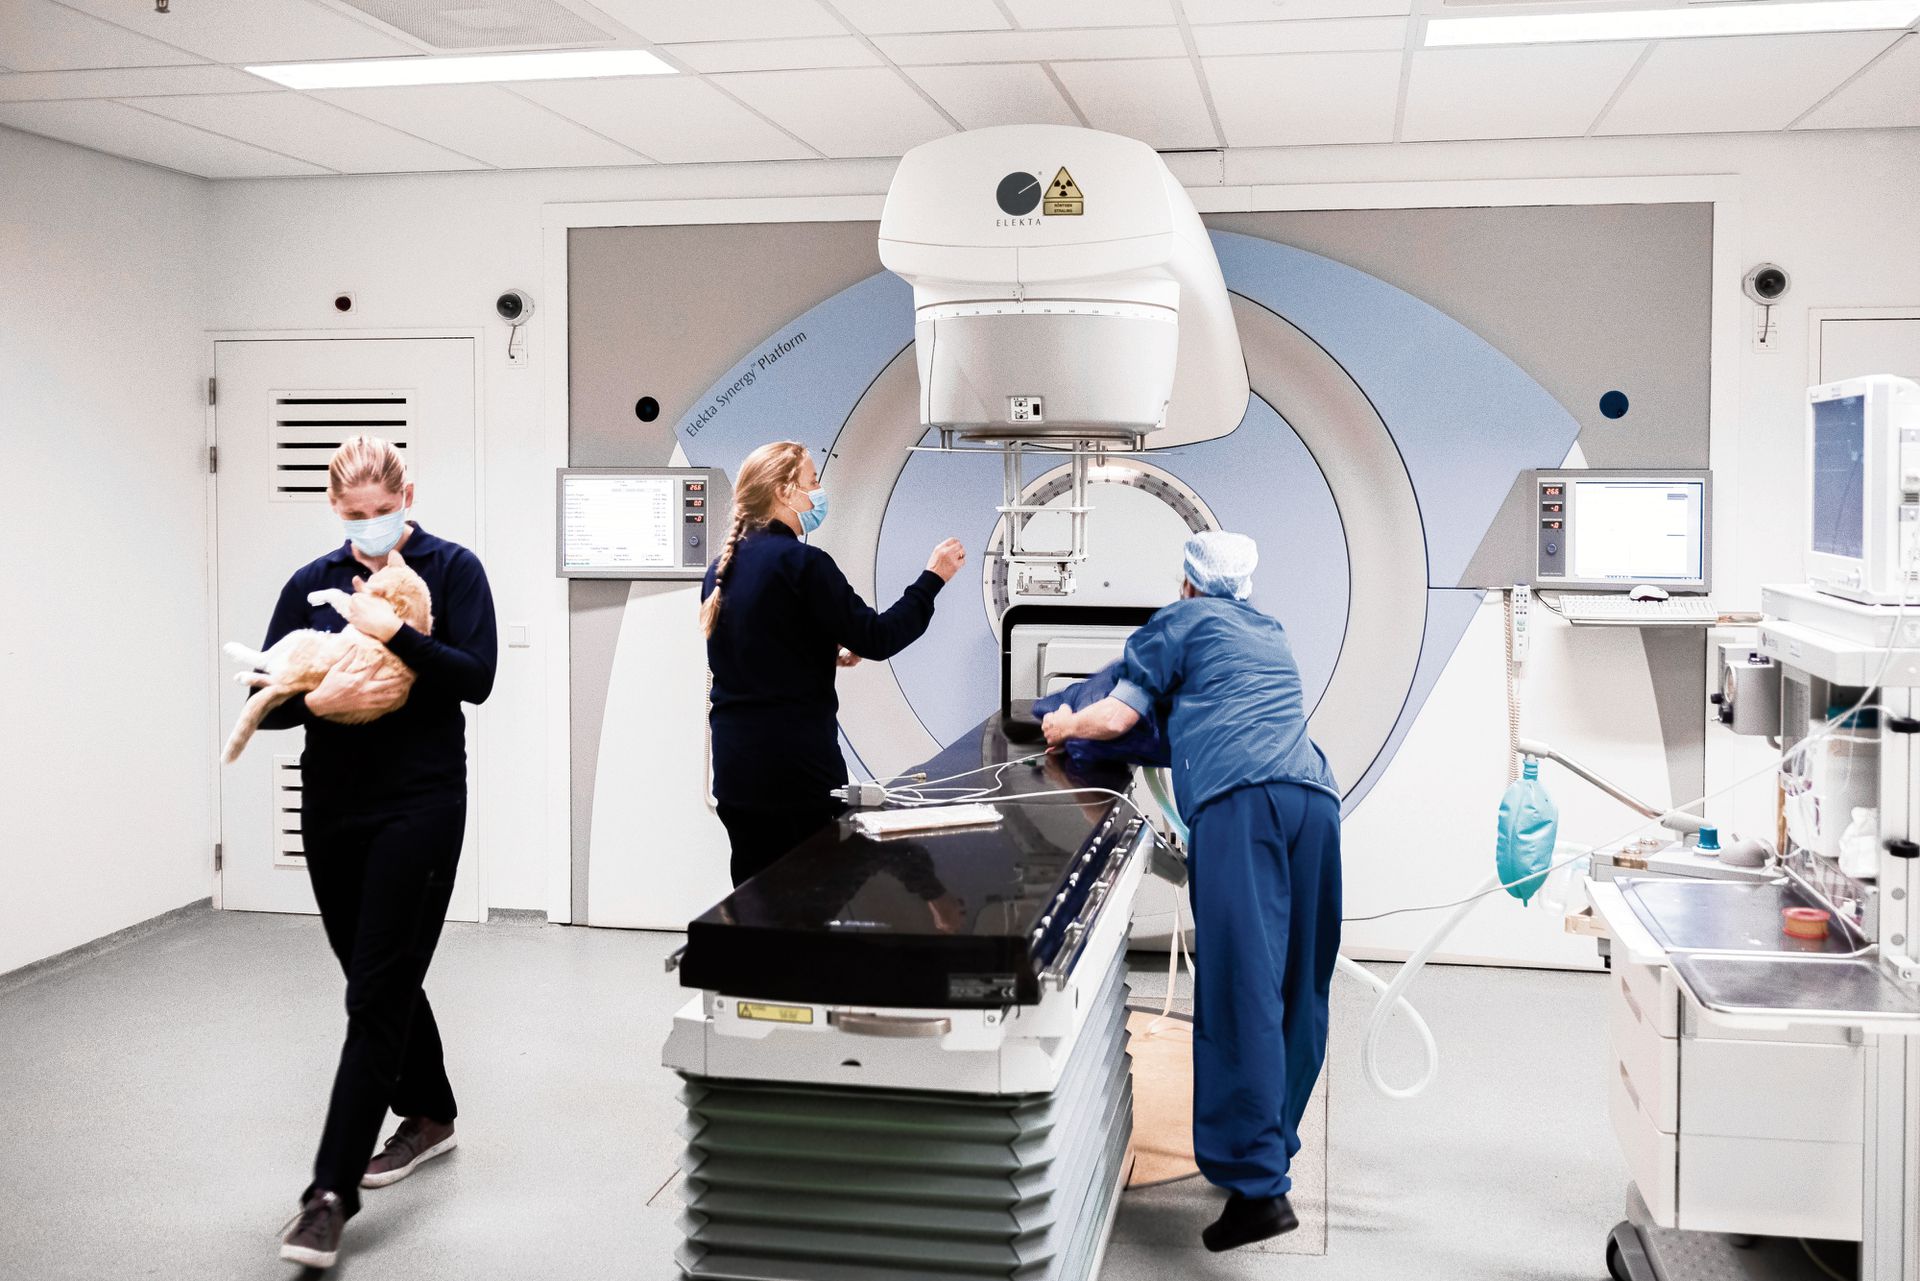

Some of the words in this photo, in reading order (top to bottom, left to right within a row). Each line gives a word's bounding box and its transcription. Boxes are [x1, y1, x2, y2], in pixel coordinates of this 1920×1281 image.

[996, 218, 1041, 227] ELEKTA
[685, 405, 718, 438] Elekta
[757, 331, 808, 371] Platform
